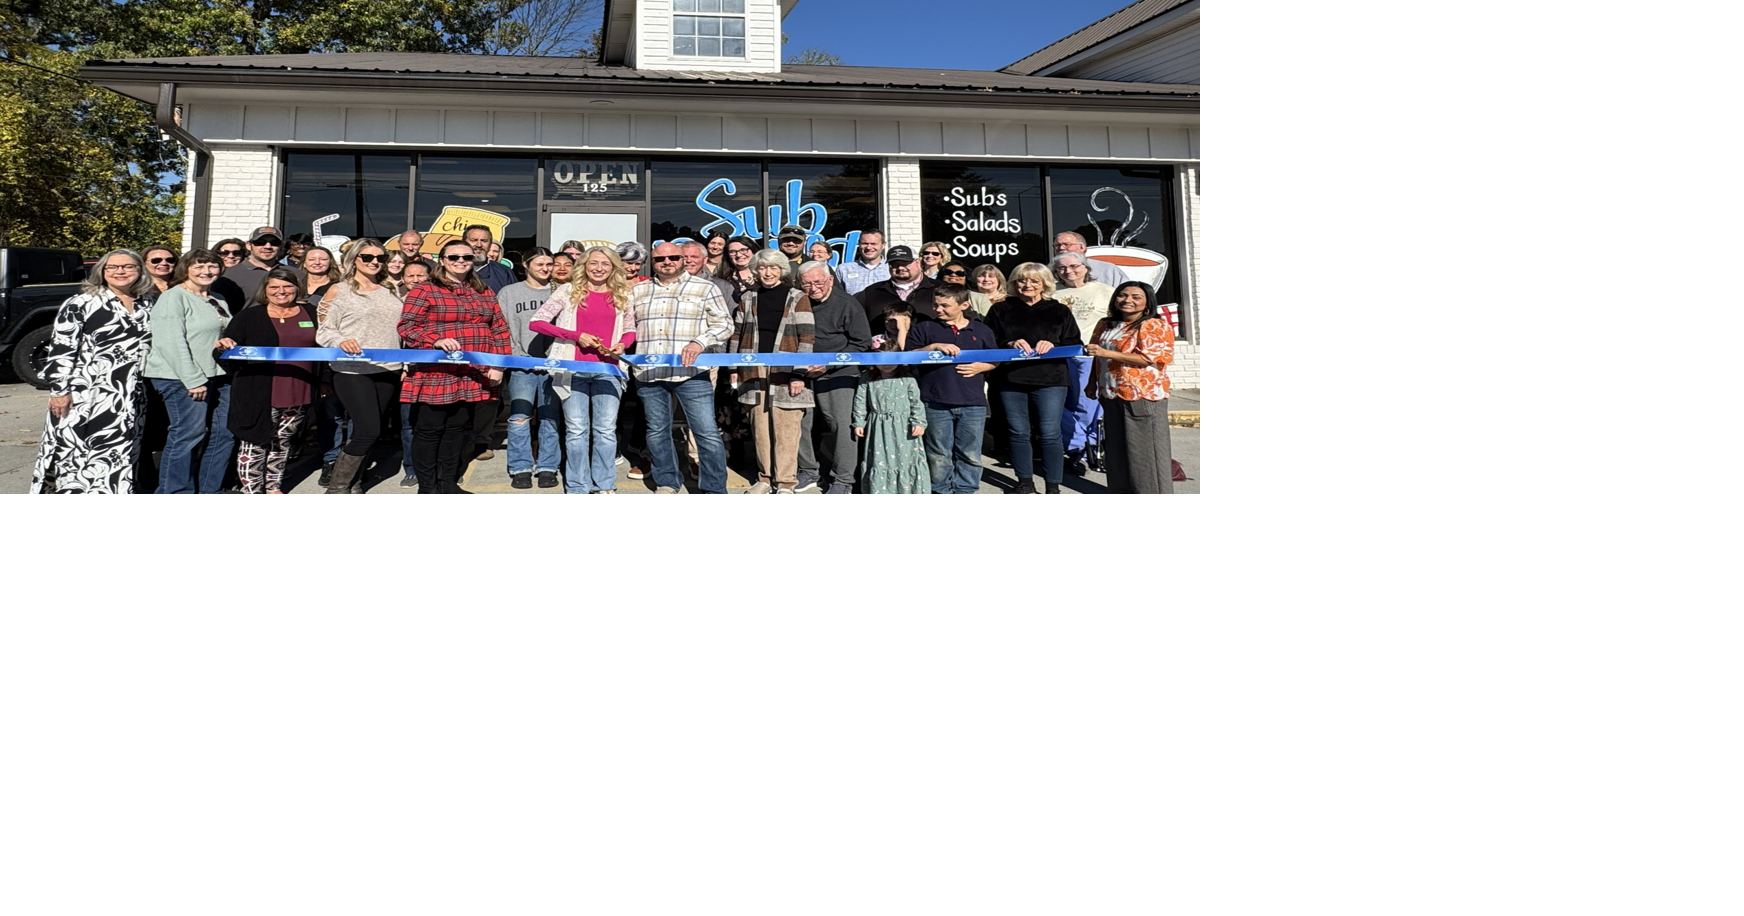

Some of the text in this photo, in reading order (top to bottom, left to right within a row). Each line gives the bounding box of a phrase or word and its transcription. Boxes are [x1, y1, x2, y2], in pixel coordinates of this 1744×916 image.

[553, 161, 639, 185] OPEN
[582, 183, 608, 193] 125
[950, 186, 1008, 207] Subs
[696, 177, 828, 241] Sub
[951, 210, 1021, 234] Salads
[952, 235, 1020, 264] Soups
[515, 300, 538, 314] OLD
